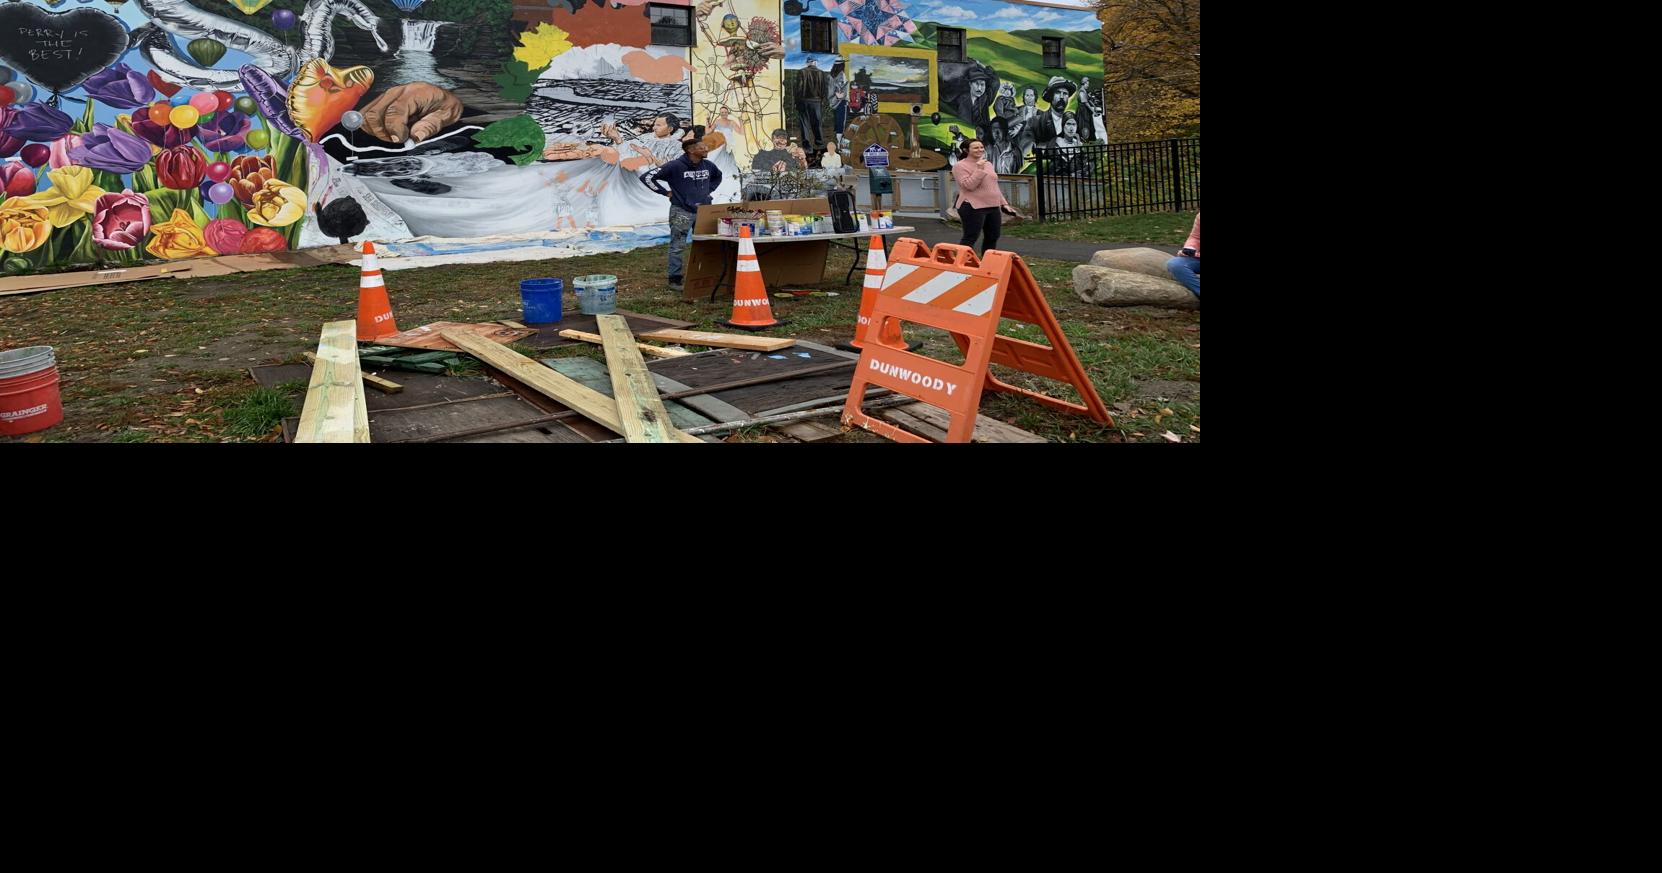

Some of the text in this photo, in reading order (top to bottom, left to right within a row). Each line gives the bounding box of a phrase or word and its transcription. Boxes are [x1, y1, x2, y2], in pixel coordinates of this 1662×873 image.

[18, 27, 89, 39] PERRY IS
[35, 39, 72, 48] THE
[28, 47, 83, 61] BEST!
[869, 358, 957, 396] DUNWOODY
